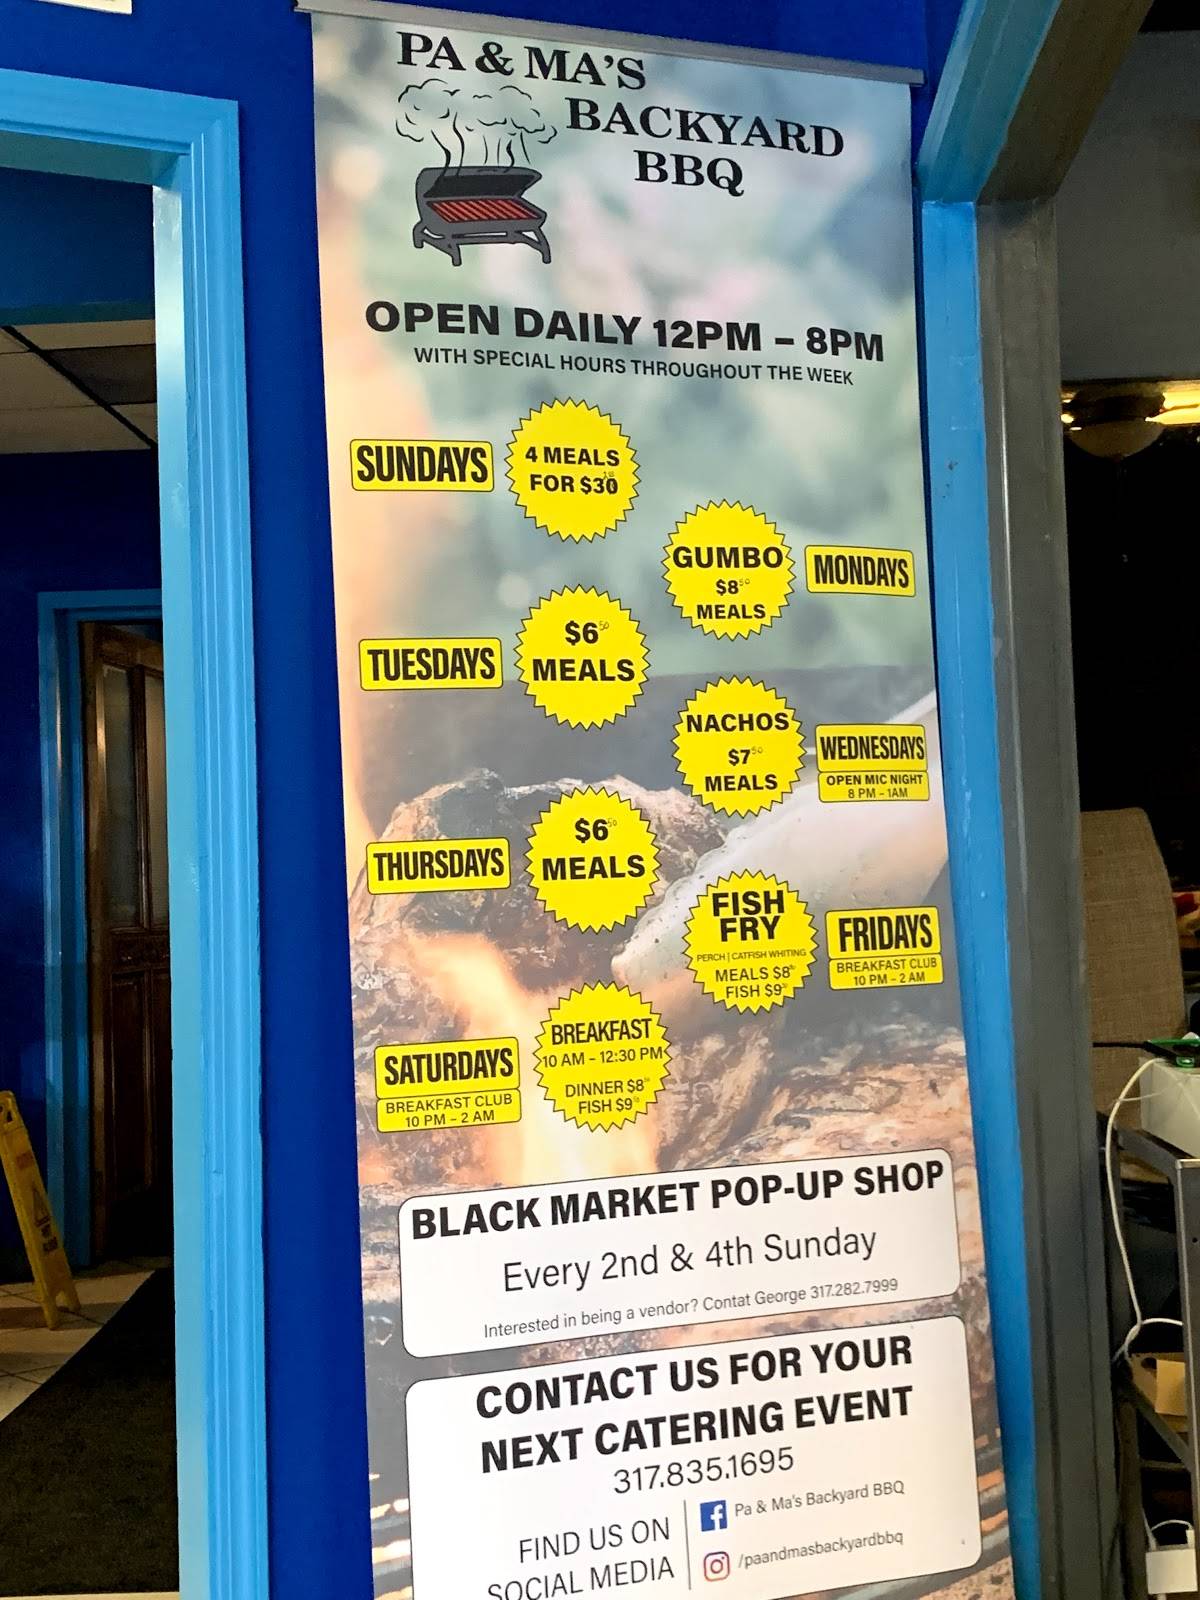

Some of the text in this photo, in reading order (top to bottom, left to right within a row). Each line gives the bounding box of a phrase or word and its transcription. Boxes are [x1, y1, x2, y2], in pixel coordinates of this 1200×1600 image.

[396, 31, 466, 71] PA
[475, 41, 515, 76] &
[565, 97, 845, 158] BACKYARD
[634, 149, 745, 197] BBQ
[365, 300, 500, 336] OPEN
[514, 307, 642, 345] DAILY
[653, 319, 762, 352] 12PM
[806, 326, 884, 362] 8PM
[414, 347, 854, 386] WITH SPECIAL HOURS THROUGHOUT THE WEEK
[357, 445, 488, 483] SUNDAYS
[525, 447, 620, 467] 4 MEALS
[530, 474, 575, 493] FOR
[580, 475, 618, 495] $30
[672, 546, 784, 569] GUMBO
[814, 554, 909, 588] MONDAYS
[696, 604, 766, 620] MEALS
[367, 647, 496, 681] TUESDAYS
[532, 658, 635, 682] MEALS
[686, 712, 790, 733] NACHOS
[820, 735, 925, 761] WEDNESDAYS
[705, 774, 778, 792] MEALS
[826, 774, 923, 786] OPEN MIC NIGHT
[848, 788, 855, 799] 8
[858, 788, 876, 798] PM
[887, 788, 909, 798] 1AM
[373, 847, 505, 881] THURSDAYS
[542, 854, 646, 881] MEALS
[712, 889, 785, 917] FISH
[720, 915, 780, 942] FRY
[838, 913, 933, 952] FRIDAYS
[697, 953, 726, 962] PERCH
[731, 951, 766, 960] CATFISH
[768, 948, 807, 958] WHITING
[836, 957, 938, 973] BREAKFAST CLUB
[715, 966, 769, 982] MEALS
[853, 975, 866, 986] 10
[869, 974, 888, 985] PM
[899, 973, 906, 983] 2
[908, 972, 926, 983] AM
[726, 984, 760, 999] FISH
[551, 1018, 652, 1046] BREAKFAST
[384, 1047, 513, 1086] SATURDAYS
[543, 1055, 557, 1068] 10
[560, 1053, 585, 1067] AM
[600, 1048, 636, 1064] 12:30
[639, 1046, 663, 1061] PM
[565, 1080, 624, 1098] DINNER
[386, 1093, 513, 1114] BREAKFAST CLUB
[579, 1098, 612, 1114] FISH
[405, 1116, 420, 1128] 10
[424, 1114, 446, 1126] PM
[461, 1112, 469, 1123] 2
[472, 1110, 495, 1122] AM
[411, 1160, 944, 1240] BLACK MARKET POP-UP SHOP
[504, 1228, 876, 1293] Every 2nd & 4th Sunday
[484, 1278, 899, 1339] Interested in being a vendor? Contat George 317.282.7999
[476, 1334, 912, 1419] CONTACT US FOR YOUR
[482, 1385, 914, 1473] NEXT CATERING EVENT
[613, 1446, 795, 1495] 317.835.1695
[735, 1503, 752, 1517] Pa
[756, 1499, 768, 1514] &
[806, 1484, 869, 1506] Backyard
[873, 1480, 905, 1497] BBQ
[519, 1516, 671, 1563] FIND US ON
[738, 1531, 904, 1569] /paandmasbackyardbbq
[488, 1556, 675, 1600] SOCIAL MEDIA
